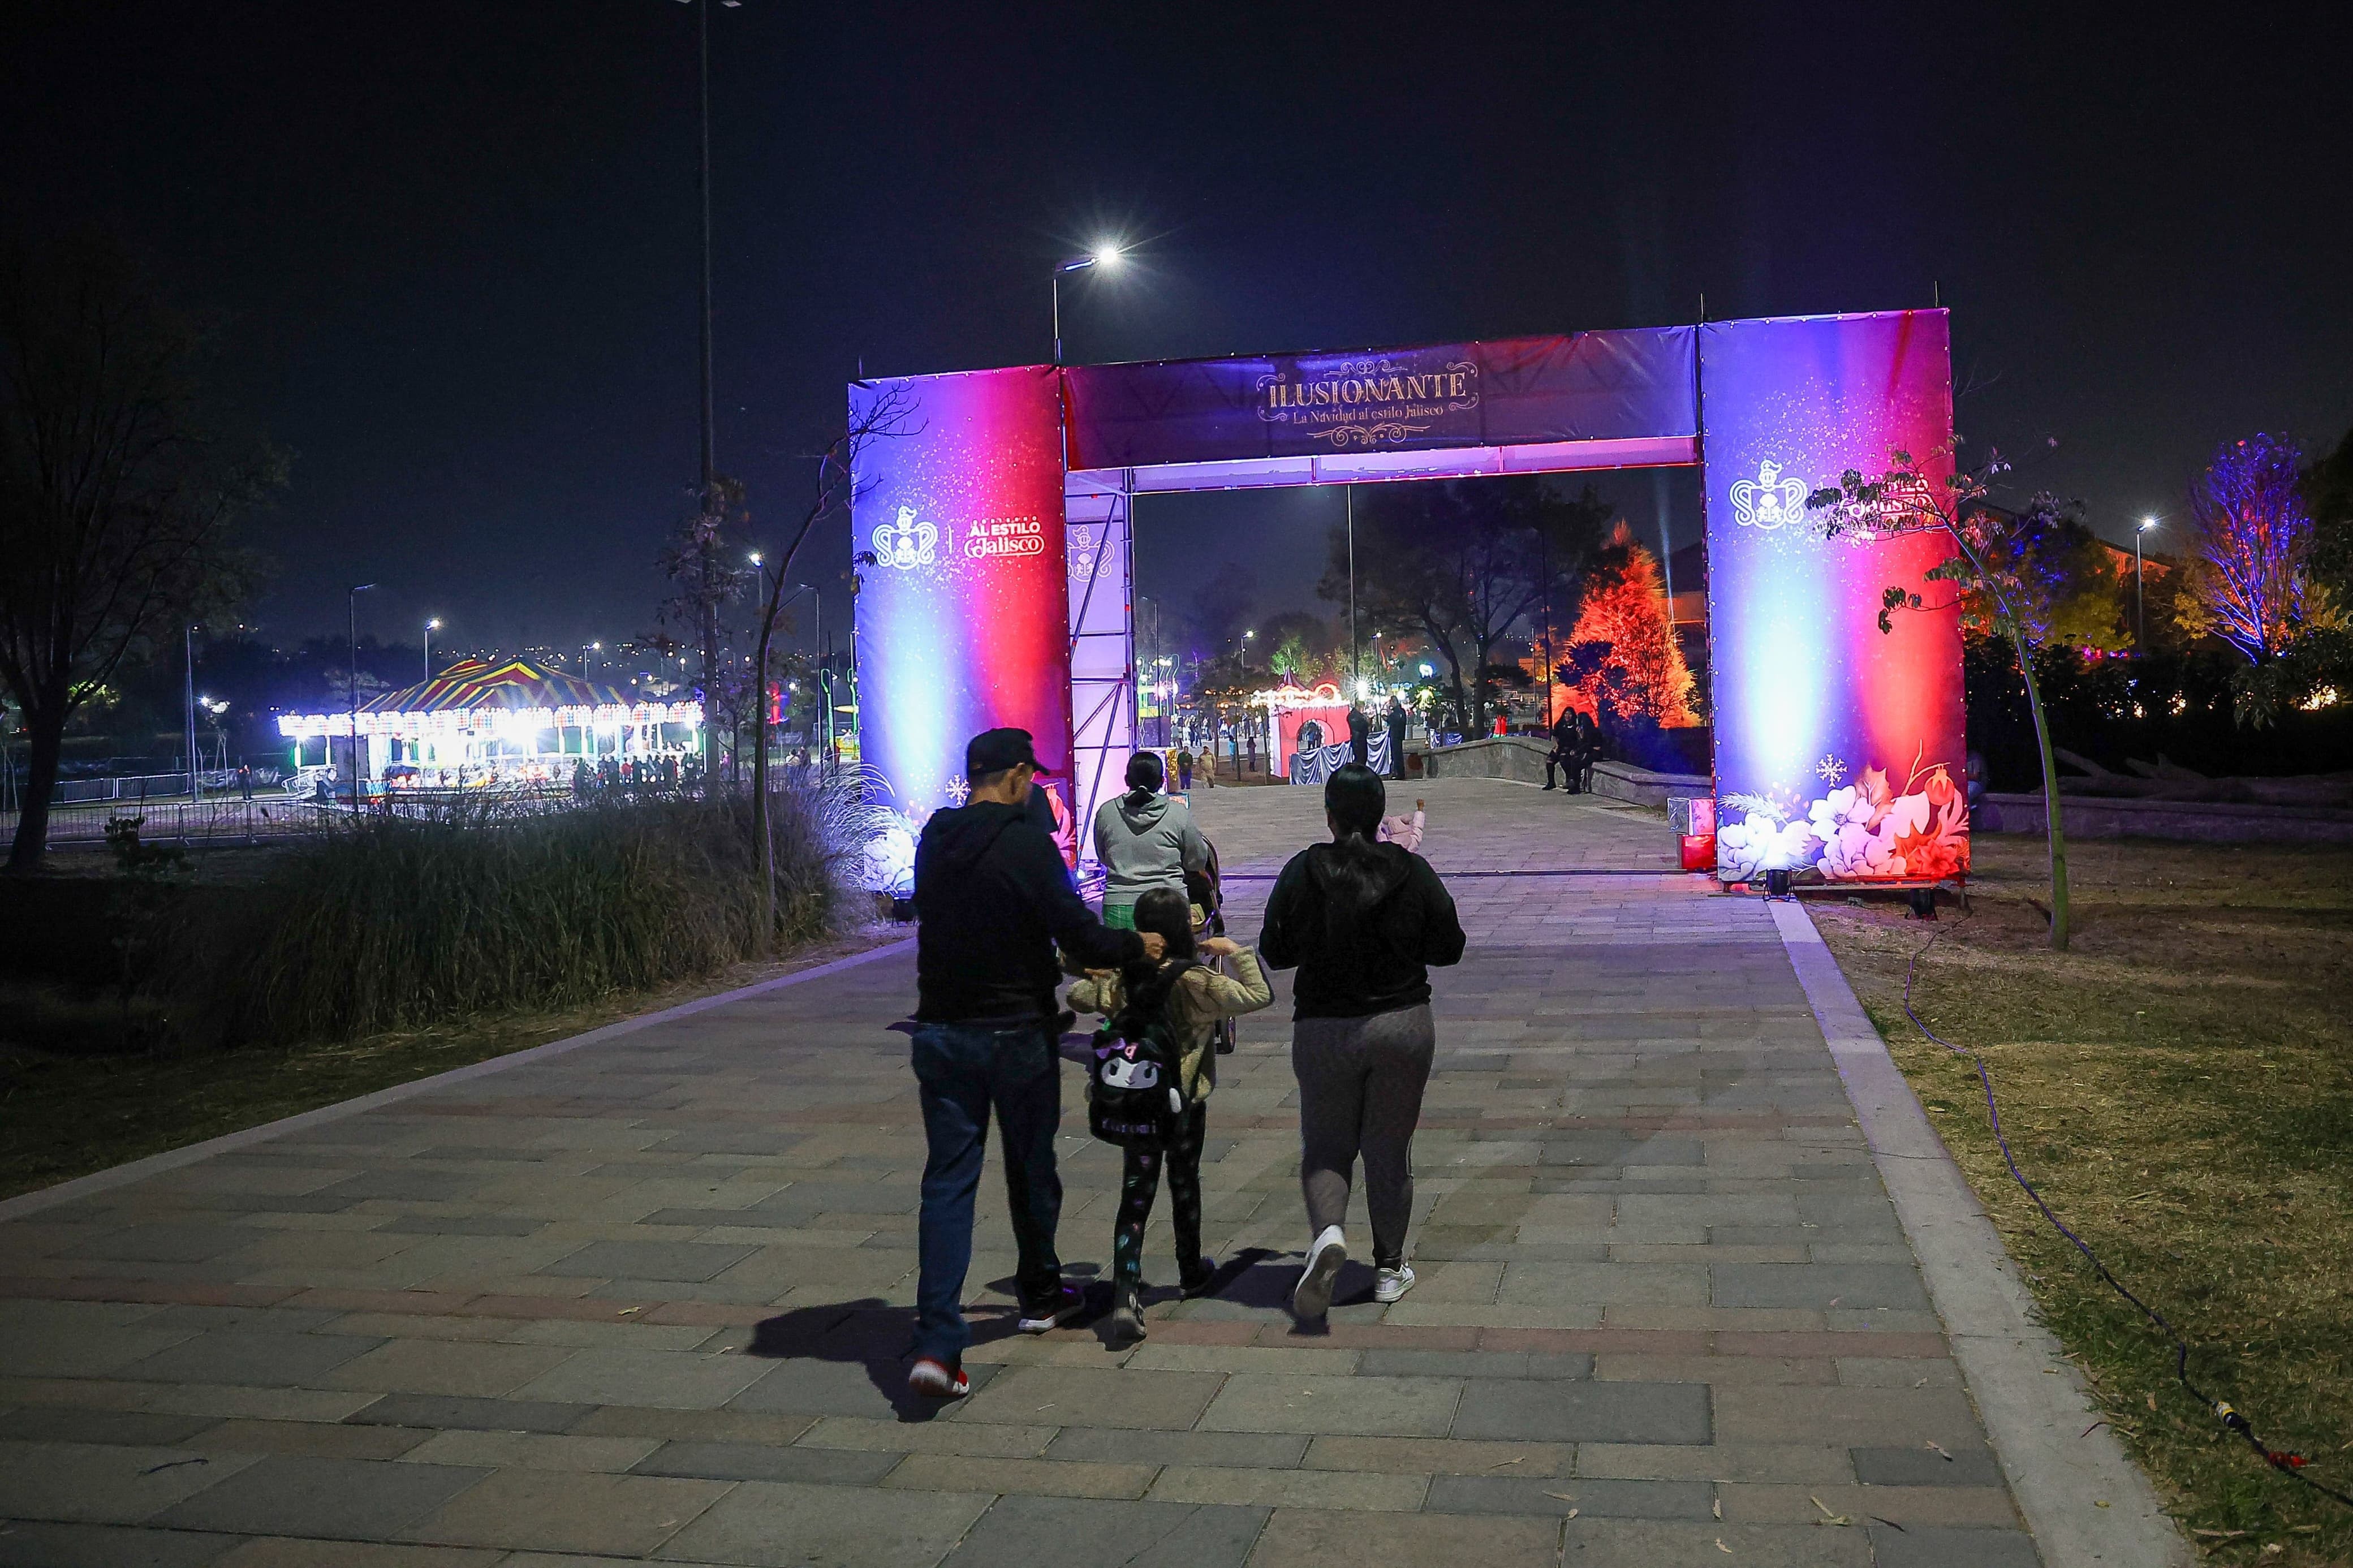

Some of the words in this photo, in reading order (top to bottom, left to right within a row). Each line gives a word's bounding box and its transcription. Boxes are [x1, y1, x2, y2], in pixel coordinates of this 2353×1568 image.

[1269, 372, 1467, 408] ILUSIONANTE
[1294, 412, 1308, 424] La
[1310, 408, 1356, 423] Navidad
[1359, 407, 1369, 420] al
[1371, 406, 1403, 420] estilo
[1404, 404, 1444, 420] Jalisco
[969, 525, 989, 537] AL
[991, 522, 1040, 535] ESTILO
[971, 536, 1039, 558] Jalisco
